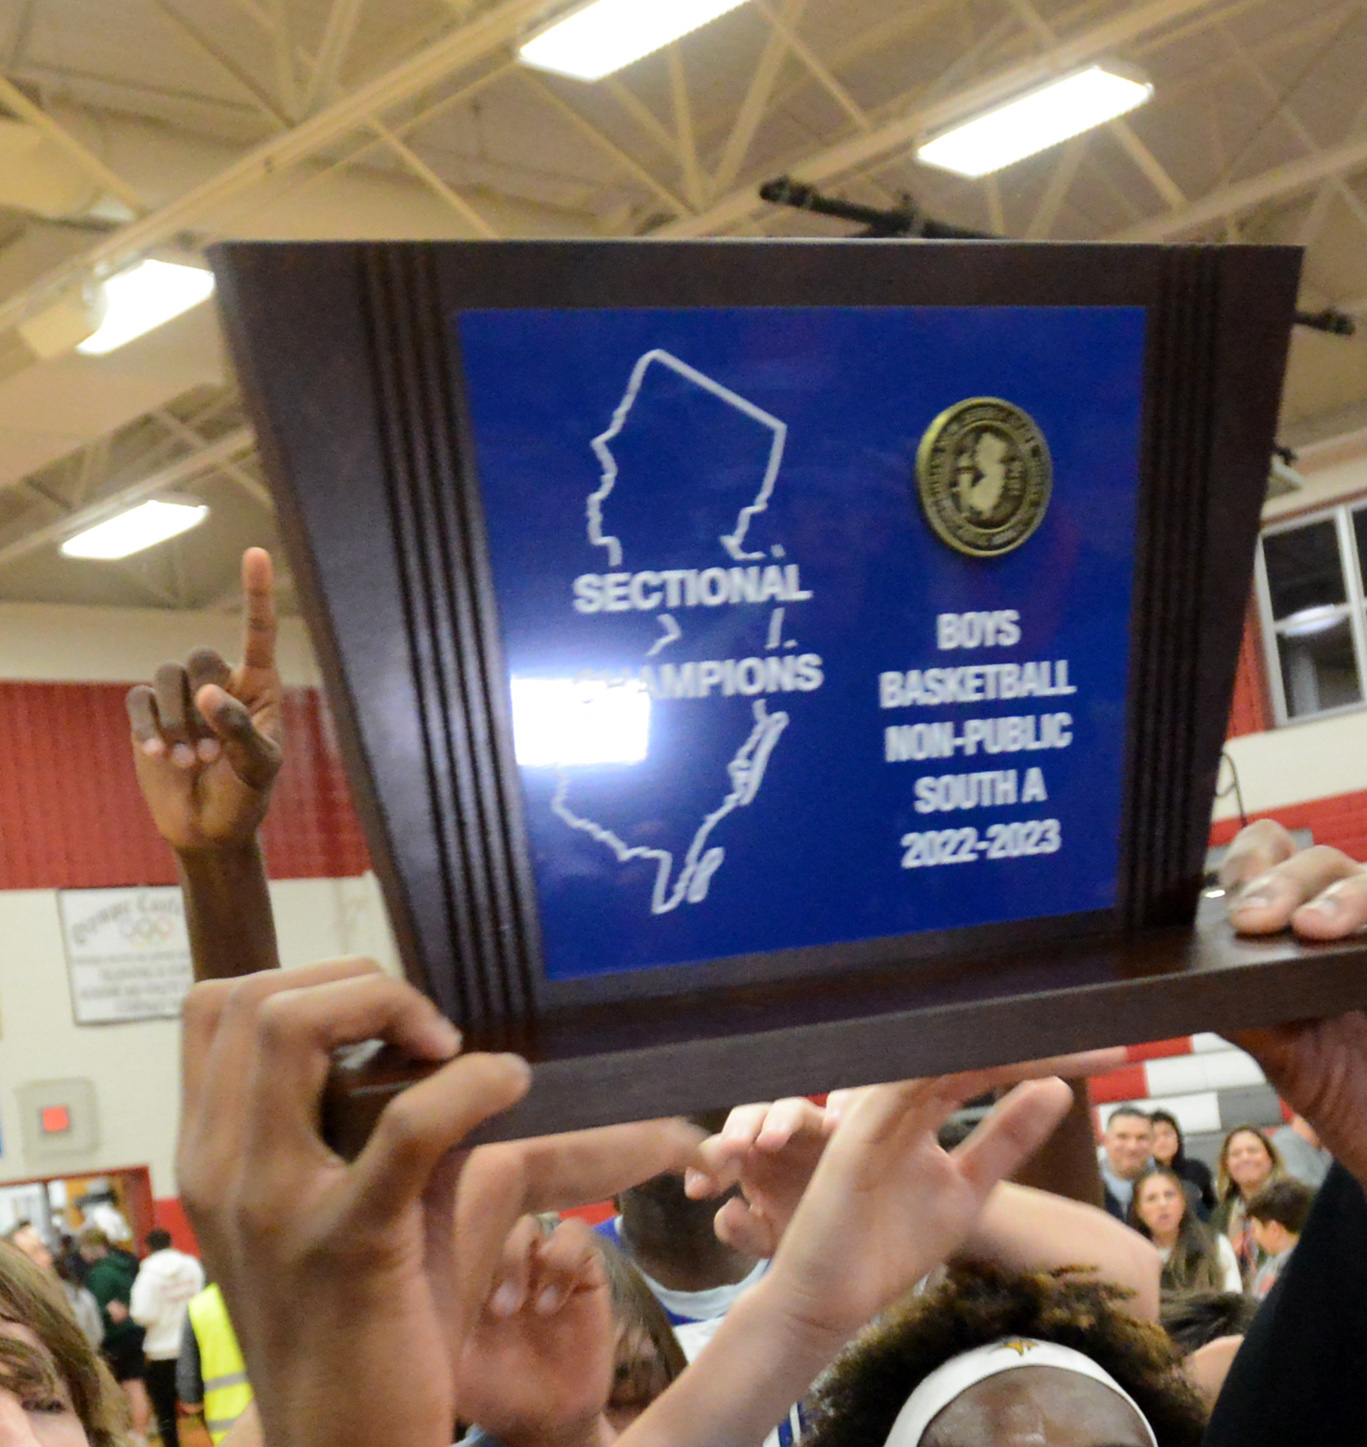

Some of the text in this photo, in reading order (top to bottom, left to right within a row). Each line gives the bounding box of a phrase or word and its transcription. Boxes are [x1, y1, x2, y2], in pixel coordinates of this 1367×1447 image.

[571, 563, 815, 615] SECTIONAL
[935, 609, 1022, 651] BOYS
[572, 652, 825, 703] AMPIONS
[878, 659, 1078, 709] BASKETBALL
[883, 711, 1074, 763] NON-PUBLIC
[913, 766, 1048, 815] SOUTH A
[899, 818, 1062, 870] 2022-2023
